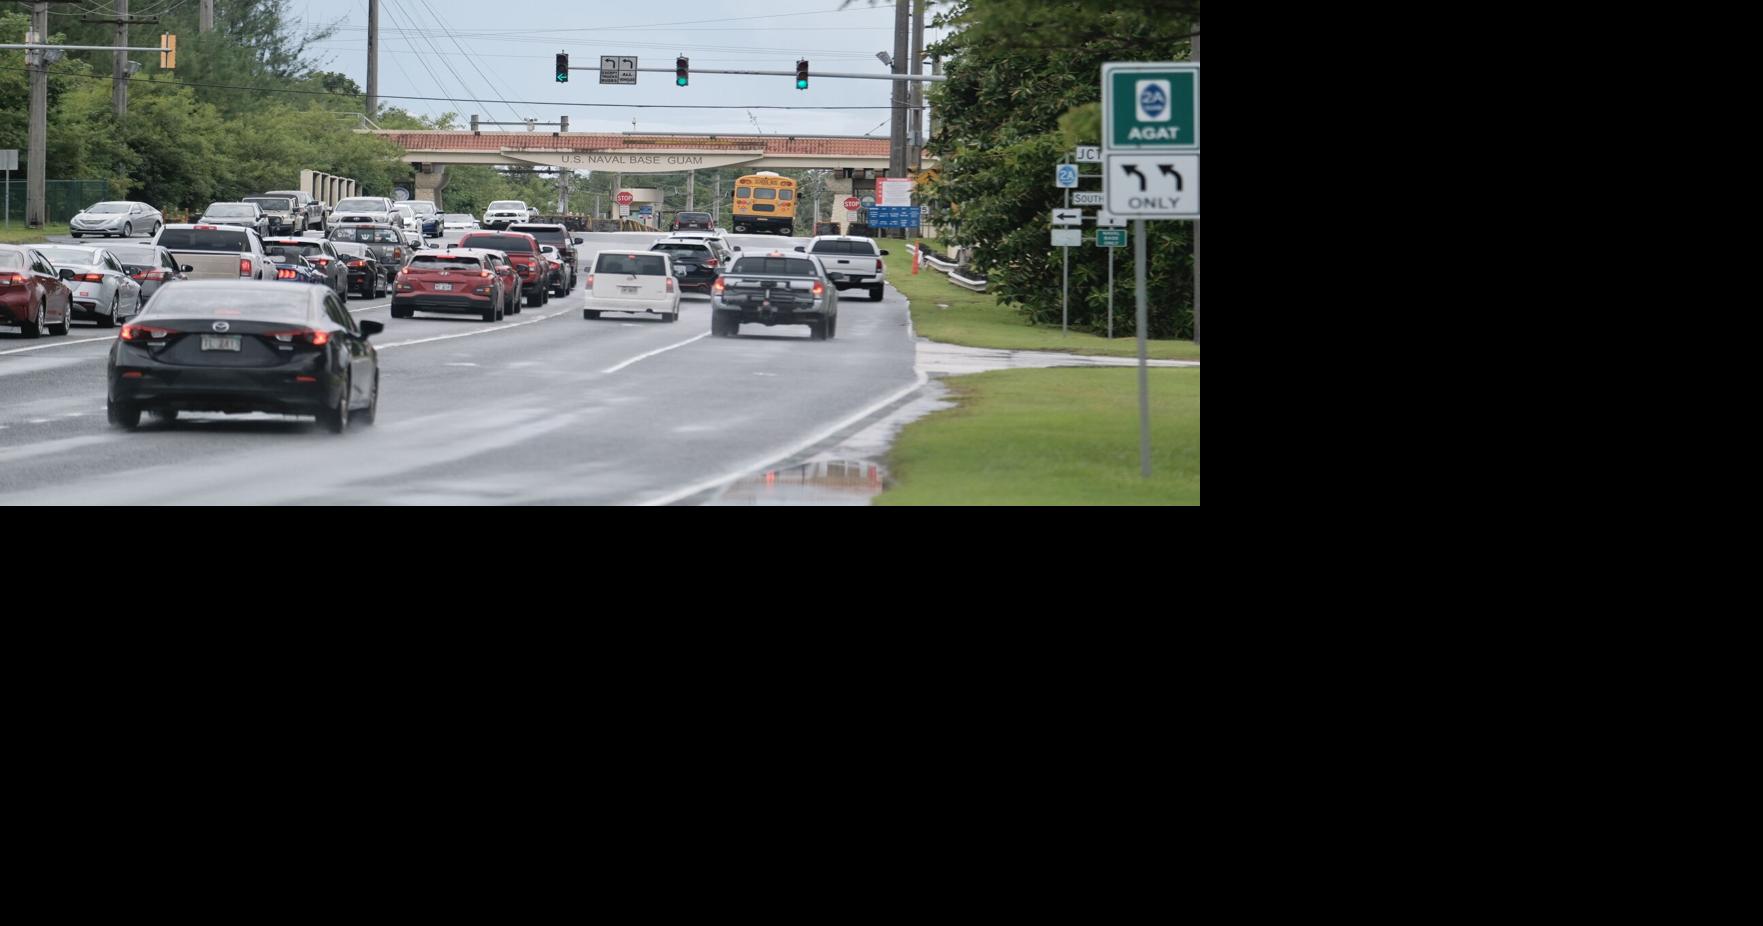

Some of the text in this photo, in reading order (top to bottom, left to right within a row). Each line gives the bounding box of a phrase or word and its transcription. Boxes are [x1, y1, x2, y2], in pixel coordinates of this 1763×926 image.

[1128, 127, 1179, 140] AGAT
[561, 155, 703, 165] U.S. NAVAL BASE GUAM
[1059, 170, 1074, 179] 2A
[1074, 193, 1105, 203] SOUTH
[1128, 197, 1180, 209] ONLY
